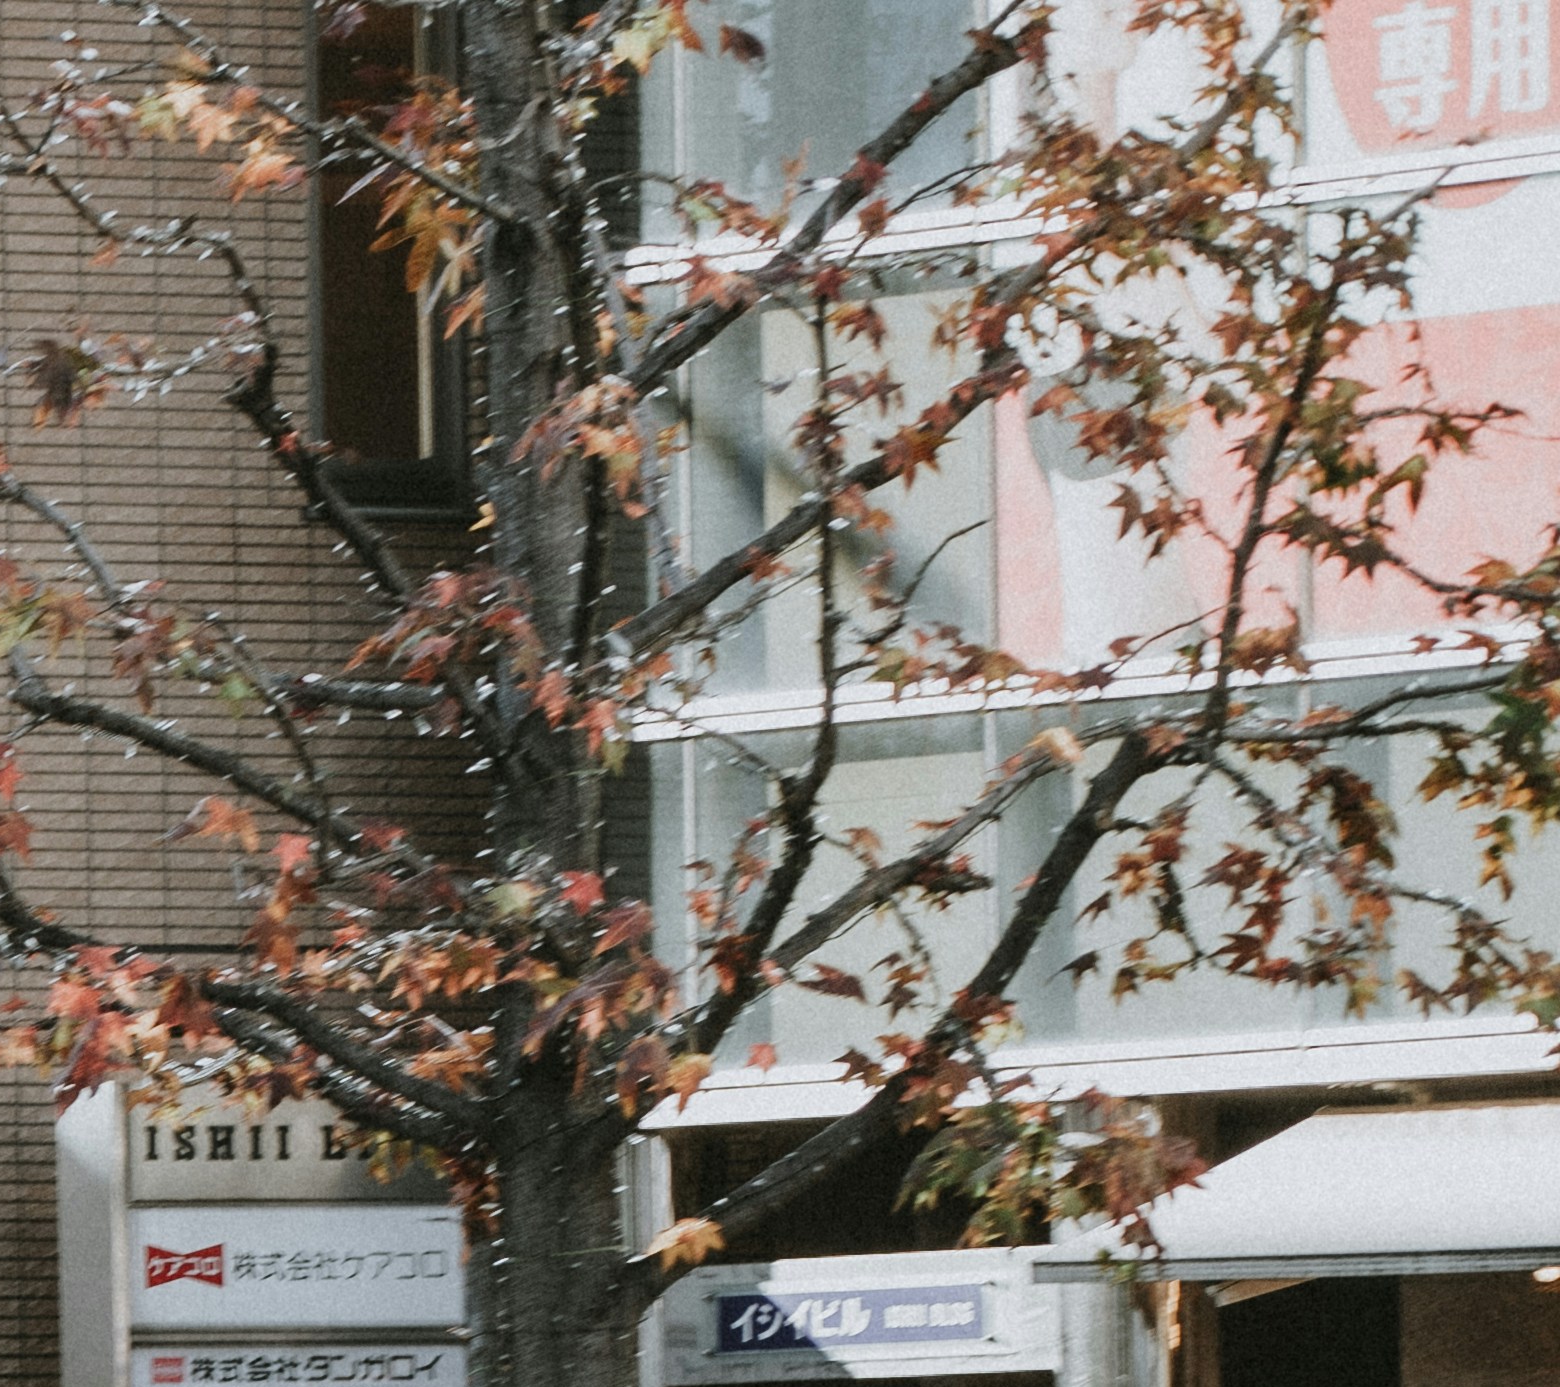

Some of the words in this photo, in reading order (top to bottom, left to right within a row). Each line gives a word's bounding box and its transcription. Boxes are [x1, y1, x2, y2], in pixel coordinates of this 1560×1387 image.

[145, 1124, 291, 1162] ISHII
[231, 1250, 449, 1282] 株式会社ケアコロ
